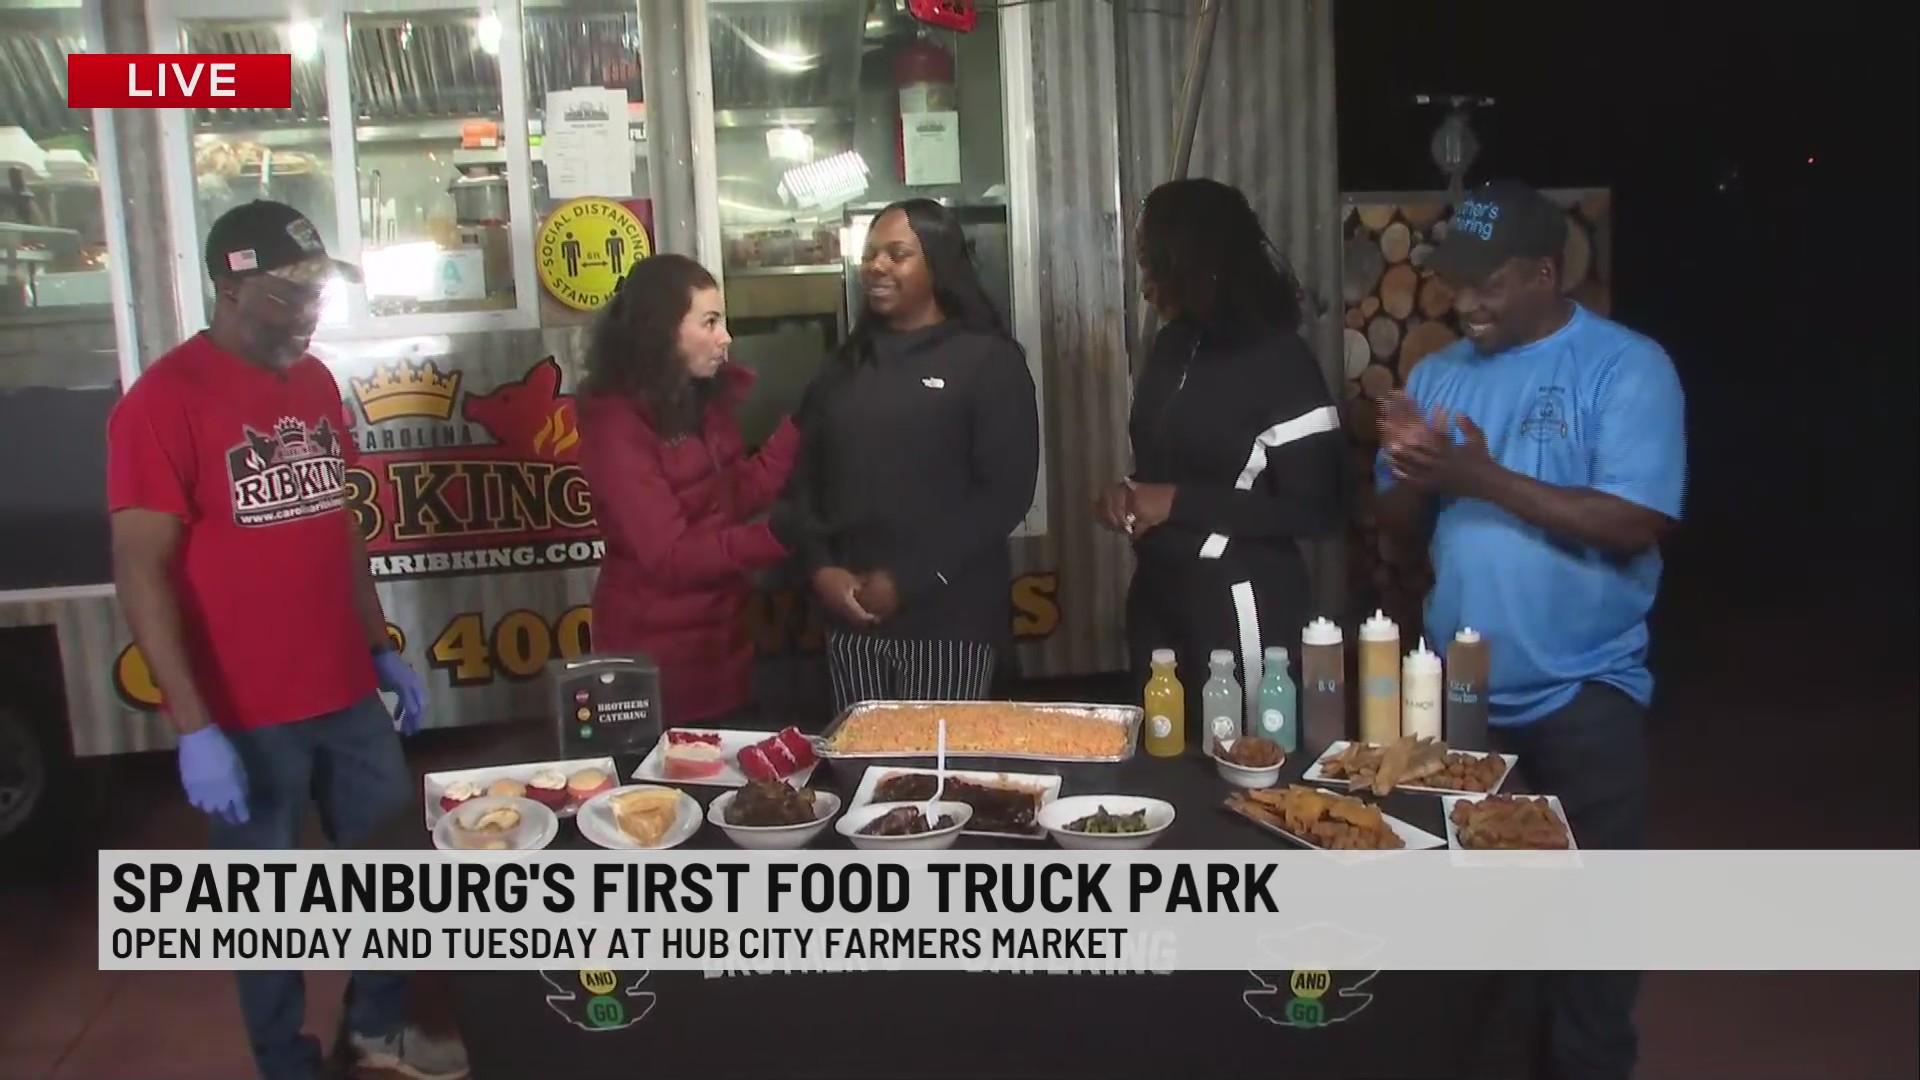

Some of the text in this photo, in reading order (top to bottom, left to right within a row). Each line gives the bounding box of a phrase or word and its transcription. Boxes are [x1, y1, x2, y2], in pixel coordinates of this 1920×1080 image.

[542, 203, 644, 268] SOCIAL DISTANCING
[552, 277, 600, 306] STAND
[388, 459, 601, 540] KING
[596, 699, 650, 712] BROTHERS
[598, 710, 648, 723] CATERING
[585, 972, 614, 987] AND
[1294, 973, 1327, 990] AND
[594, 1003, 619, 1023] GO
[1292, 1003, 1319, 1023] GO
